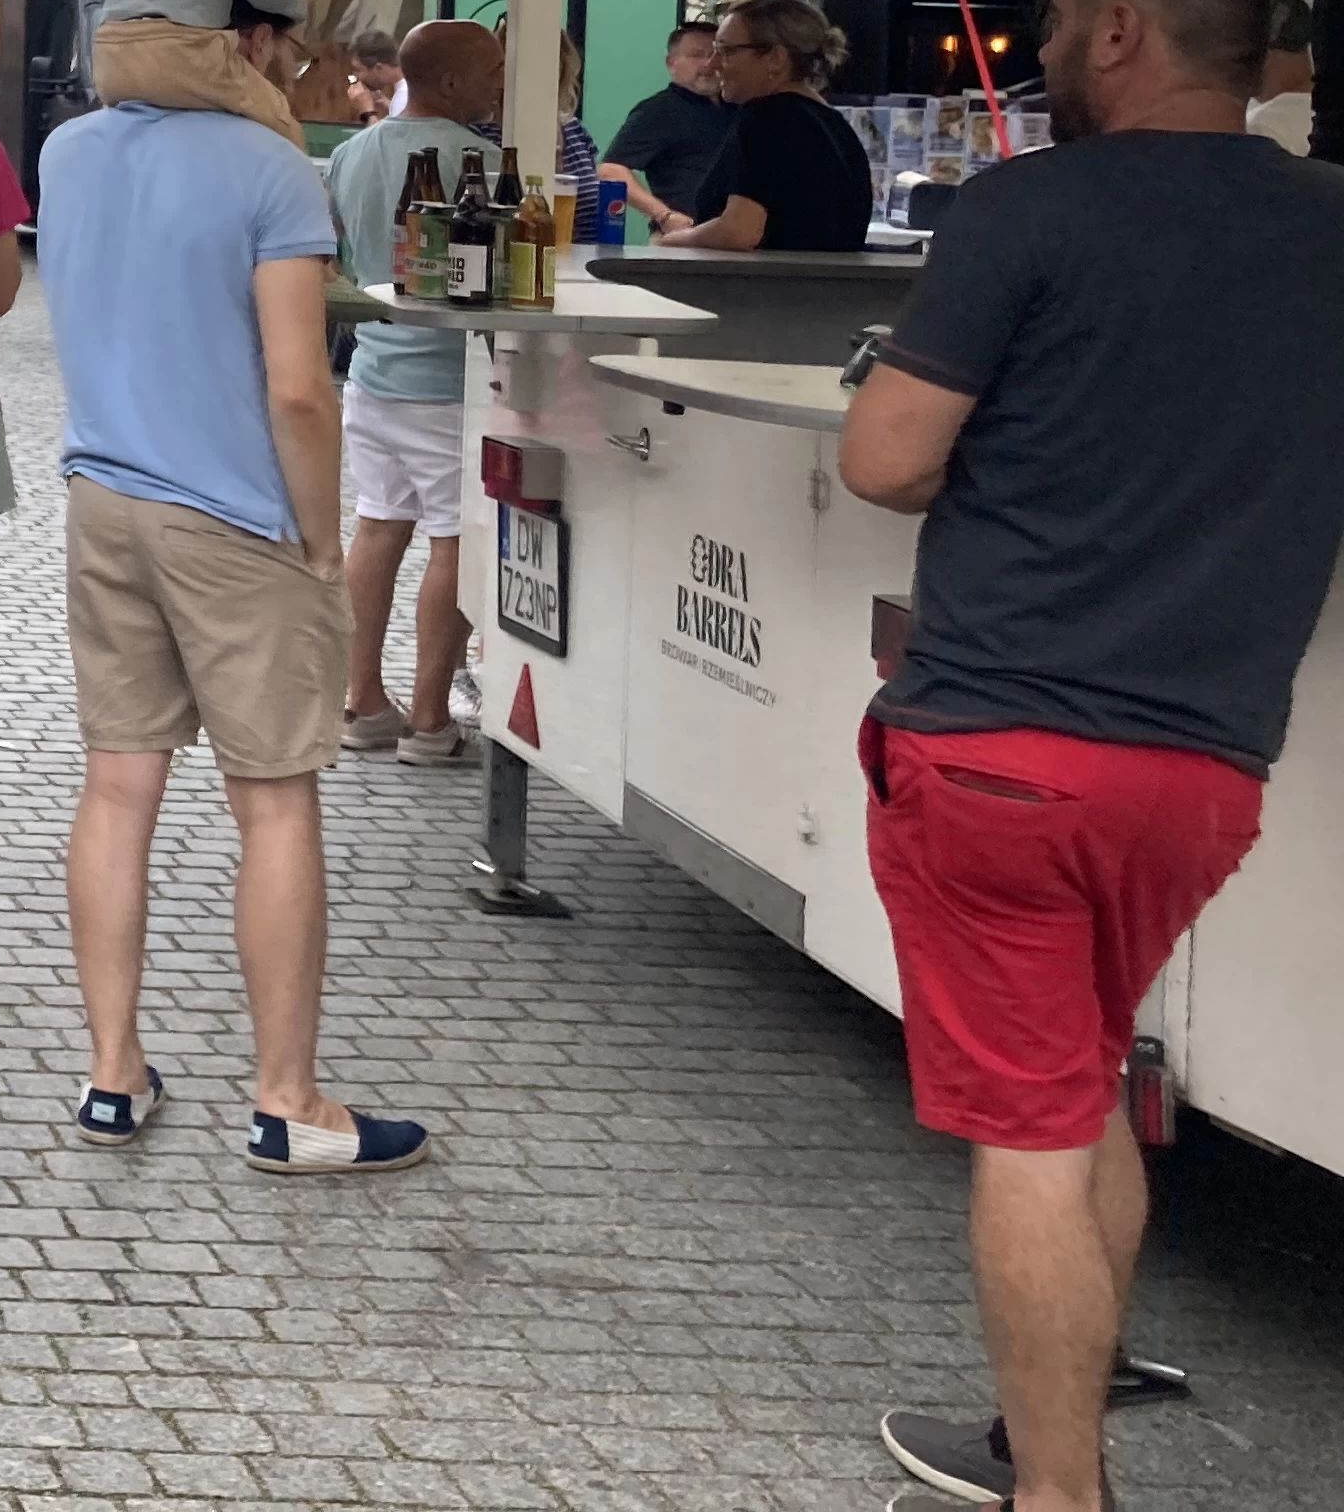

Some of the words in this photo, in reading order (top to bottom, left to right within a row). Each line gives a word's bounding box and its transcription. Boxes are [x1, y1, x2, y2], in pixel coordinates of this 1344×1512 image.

[517, 514, 543, 570] DW
[690, 533, 749, 604] ODRA
[504, 565, 557, 631] 723NP
[675, 583, 762, 669] BARRELS
